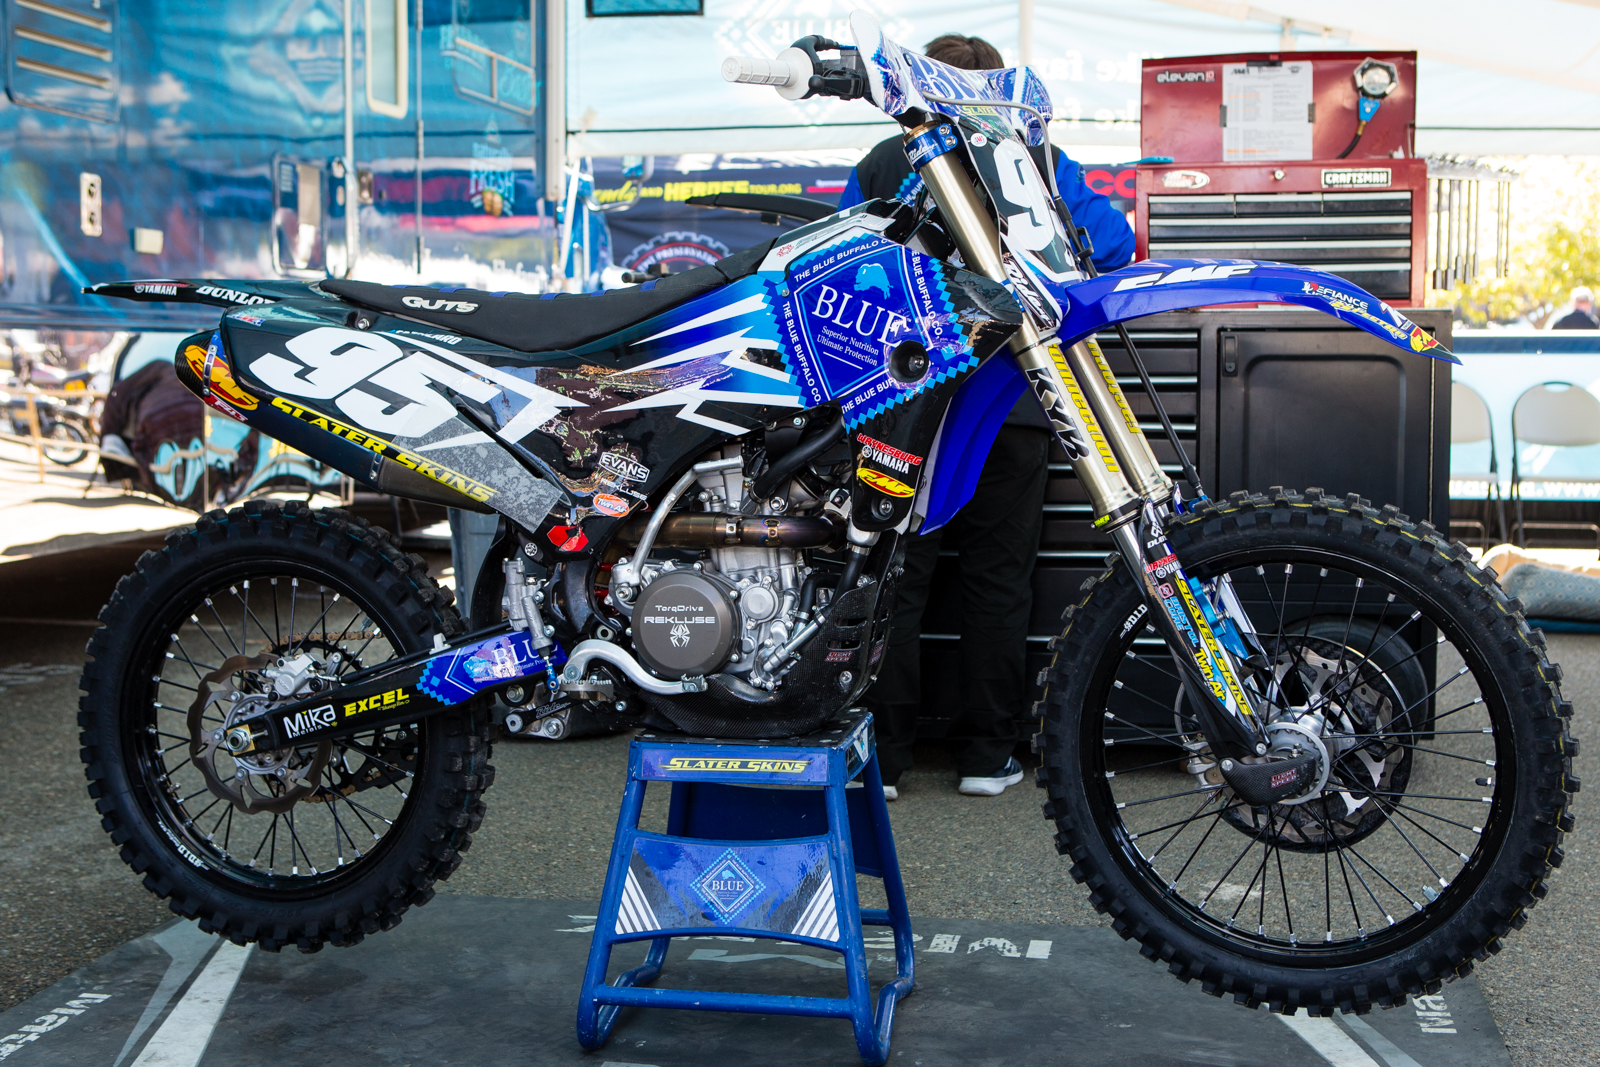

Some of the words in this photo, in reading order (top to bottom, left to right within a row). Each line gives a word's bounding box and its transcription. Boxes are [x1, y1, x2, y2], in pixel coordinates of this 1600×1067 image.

[1324, 171, 1389, 185] CRAFTSMAN
[993, 138, 1056, 252] 9
[793, 269, 811, 283] THE
[812, 256, 836, 274] BLUE
[836, 239, 880, 261] BUFFALO
[911, 255, 924, 278] BLUE
[144, 285, 178, 297] YAMAHA
[1112, 264, 1263, 293] FMF
[402, 296, 480, 313] GUTS
[782, 301, 792, 319] THE
[915, 276, 936, 321] BUFFALO
[811, 284, 909, 348] BLUE
[786, 319, 800, 344] BLUE
[821, 325, 849, 344] Superior
[848, 336, 880, 357] Nutrition
[817, 334, 844, 354] Ultimate
[843, 345, 879, 367] Protection
[794, 343, 816, 388] BUFFALO
[249, 327, 500, 438] 95
[854, 388, 877, 407] BLUE
[1025, 367, 1090, 461] KYB
[271, 396, 389, 455] SLATER
[395, 452, 495, 503] SKINS
[857, 433, 923, 466] WAYNESBURG
[872, 449, 910, 475] YAMAHA
[601, 454, 648, 480] EVANS
[857, 468, 915, 494] FMF
[644, 616, 716, 624] REKLUSE
[655, 605, 704, 613] TorqDrive
[1169, 596, 1201, 648] BRISTOL
[1194, 648, 1215, 680] Twin
[1210, 680, 1227, 701] Air
[1216, 655, 1253, 716] SKINS
[343, 688, 410, 717] EXCEL
[282, 704, 338, 739] Mika
[292, 725, 323, 738] Metals
[667, 757, 740, 773] SLATER
[746, 758, 811, 774] SKINS
[711, 880, 745, 892] BLUE
